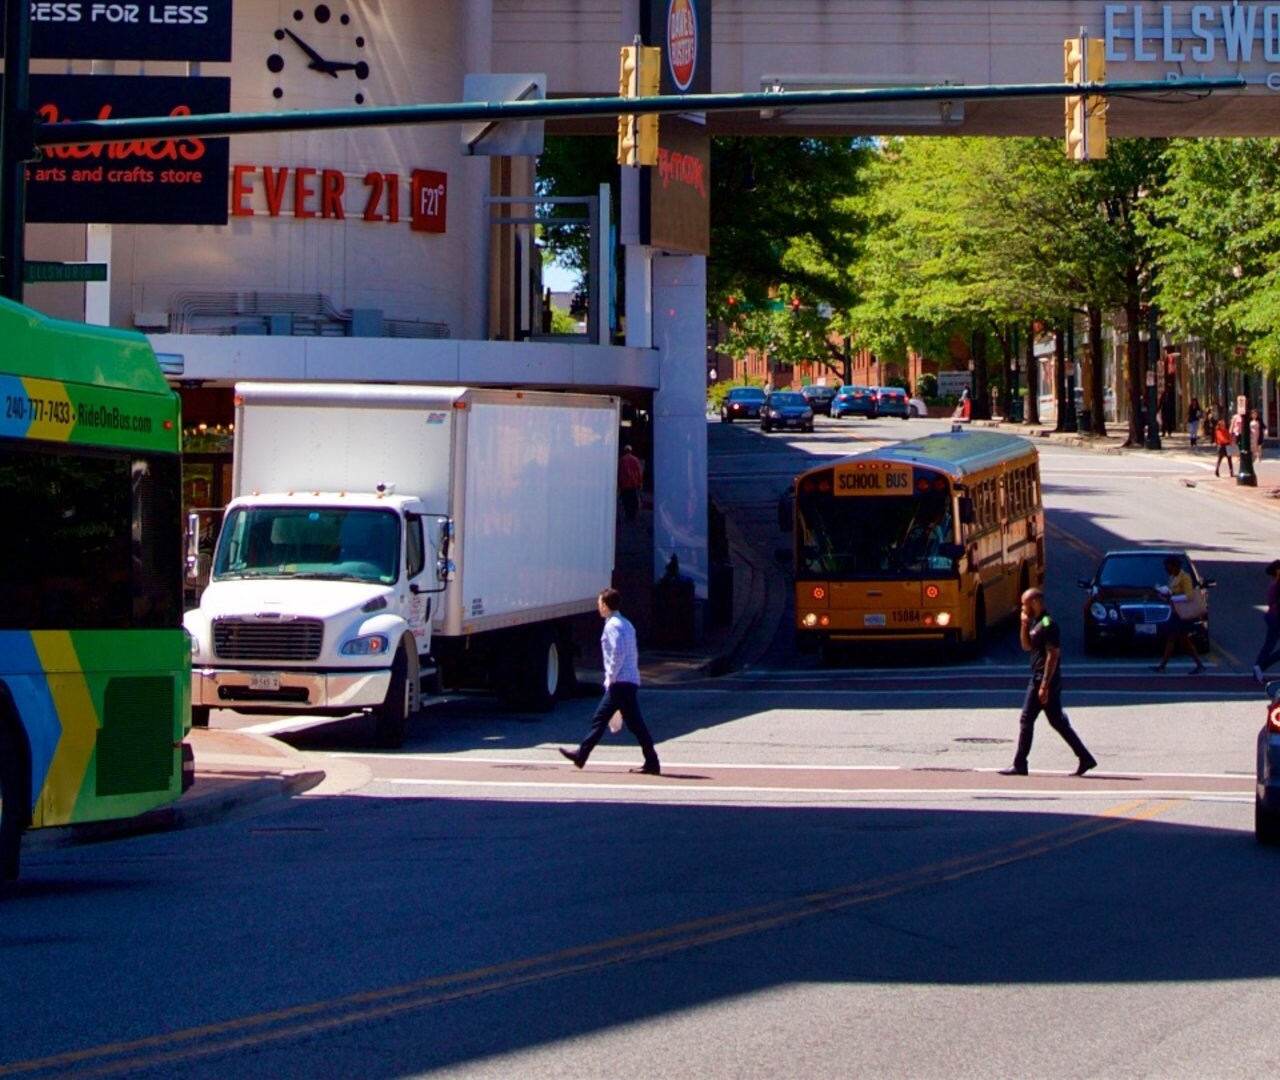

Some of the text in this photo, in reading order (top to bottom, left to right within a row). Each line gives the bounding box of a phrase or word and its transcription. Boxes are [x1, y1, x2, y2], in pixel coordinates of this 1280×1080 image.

[92, 4, 139, 22] FOR
[149, 5, 208, 24] LESS
[35, 168, 66, 182] arts
[72, 167, 102, 182] and
[107, 167, 153, 182] crafts
[160, 169, 202, 183] store
[232, 165, 399, 222] EVER 21
[30, 265, 91, 279] ELLSWORTH
[6, 396, 152, 433] 240-777-7433 RideOnBus.com
[839, 473, 908, 489] SCHOOL BUS
